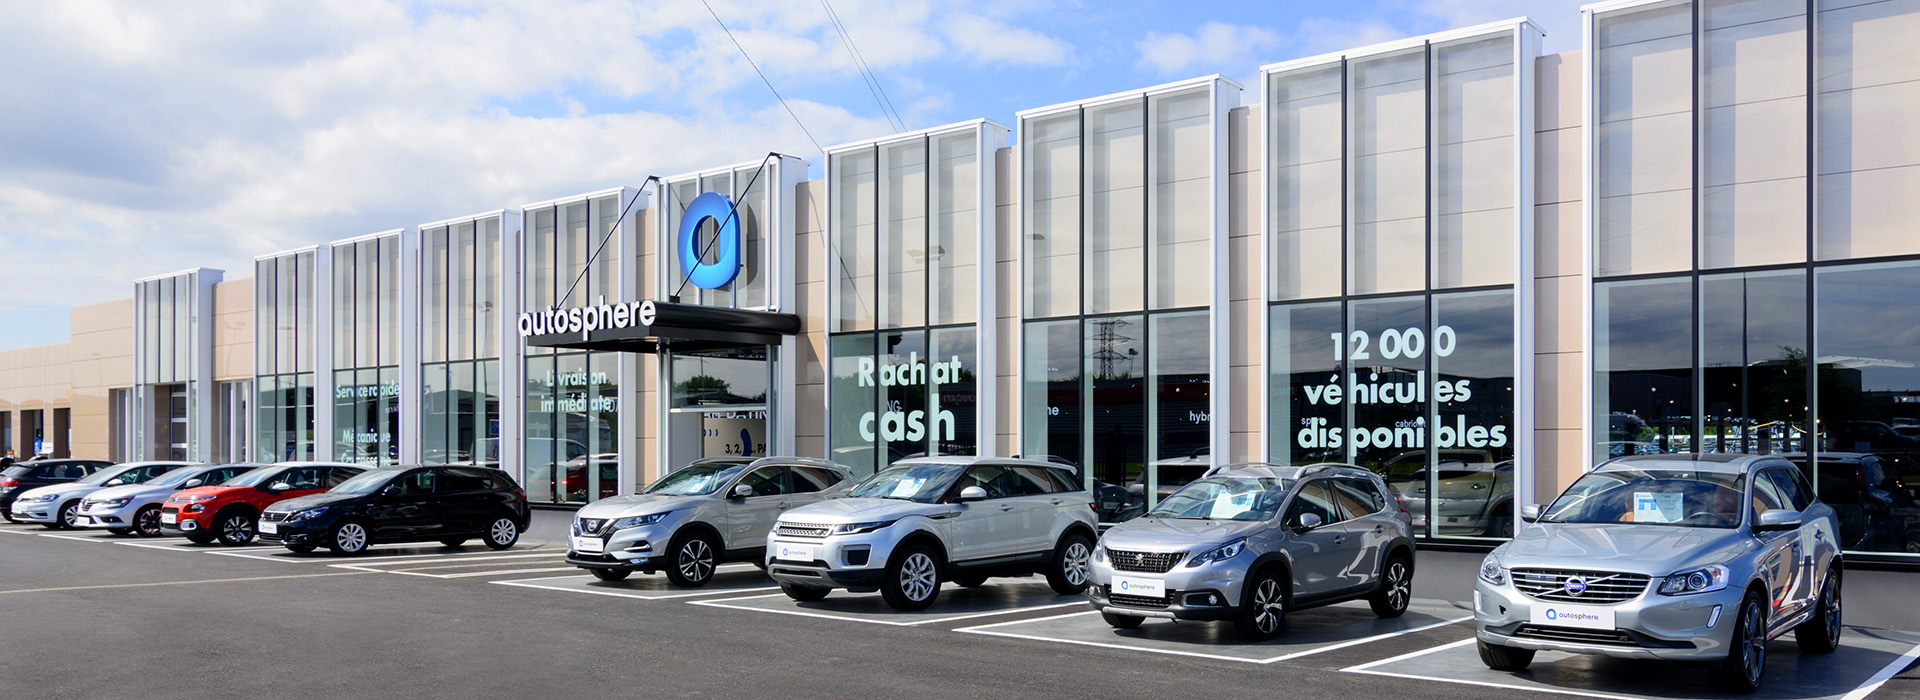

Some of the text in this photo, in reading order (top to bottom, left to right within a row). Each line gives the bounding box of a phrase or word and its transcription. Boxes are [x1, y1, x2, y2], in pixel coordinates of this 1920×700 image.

[518, 294, 656, 341] autosphere
[1331, 325, 1456, 361] 12 000
[546, 367, 607, 387] Livraison
[858, 351, 961, 387] Rachat
[540, 393, 611, 412] immédiate
[1303, 370, 1472, 405] véhicules
[858, 393, 955, 442] cash
[1297, 414, 1508, 457] disponibles
[1558, 612, 1599, 620] autosphere
